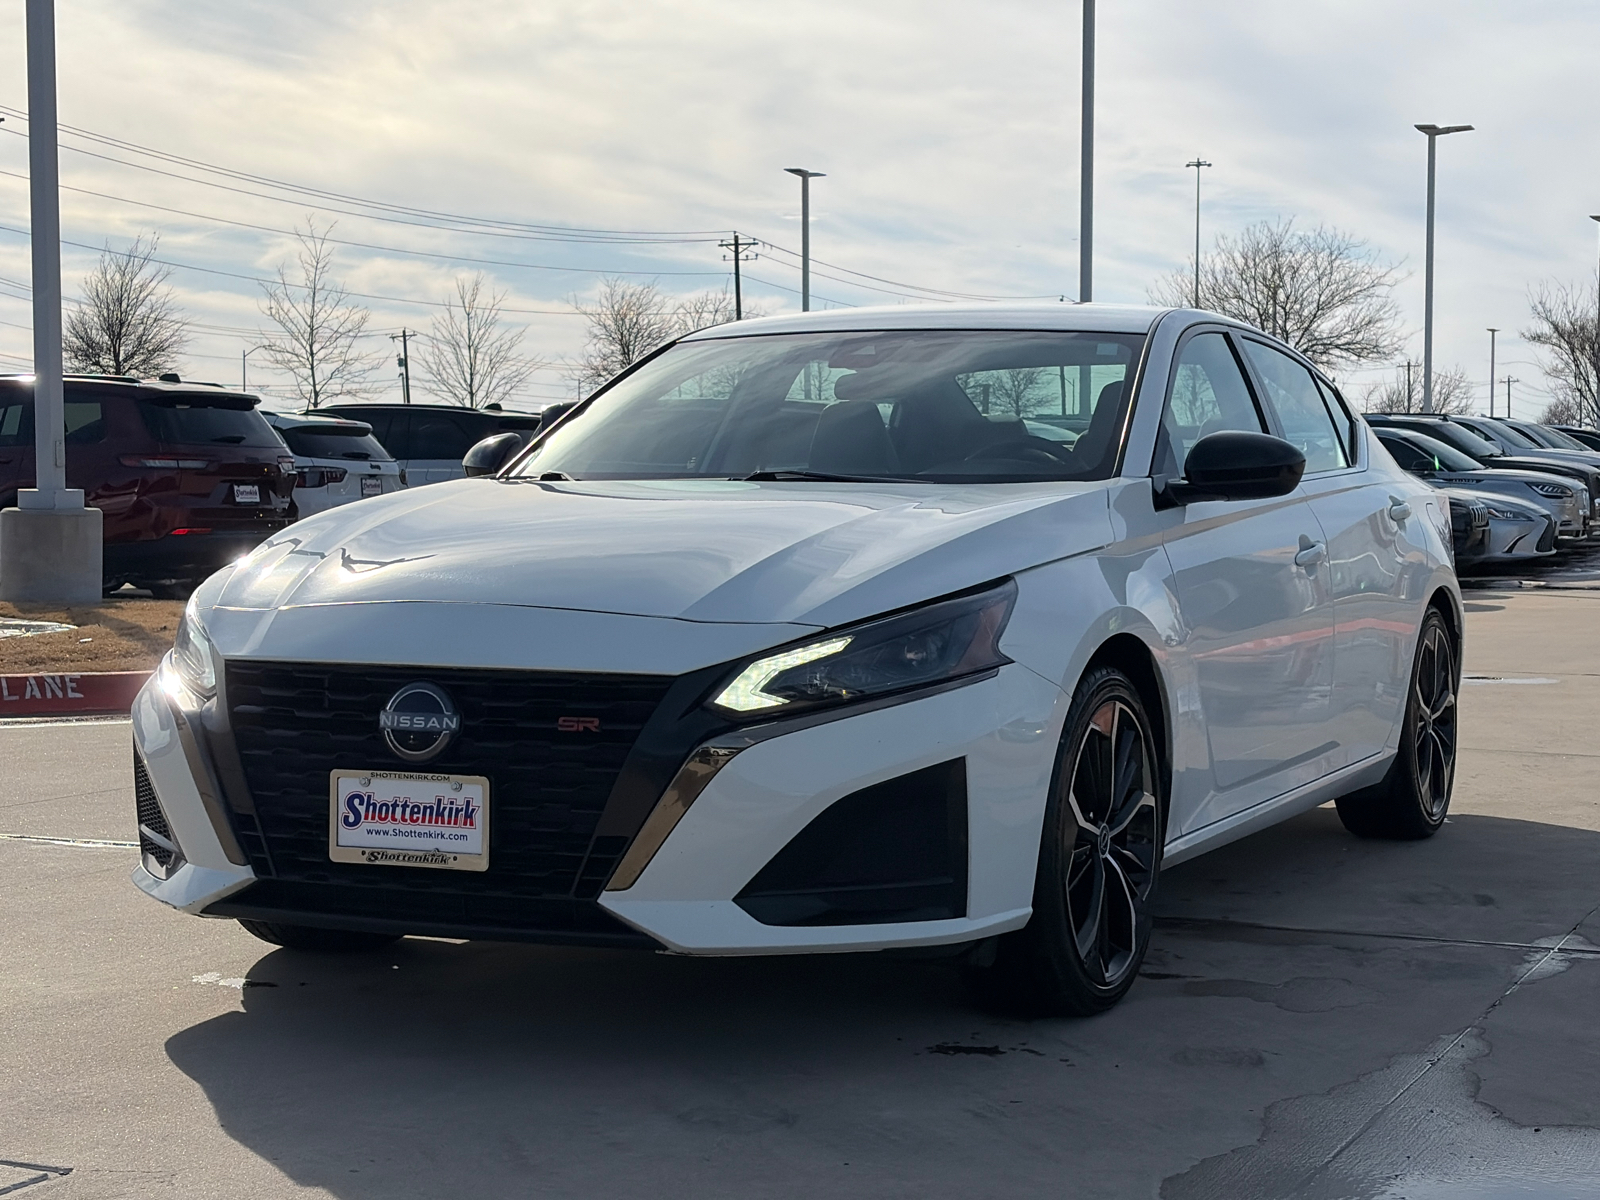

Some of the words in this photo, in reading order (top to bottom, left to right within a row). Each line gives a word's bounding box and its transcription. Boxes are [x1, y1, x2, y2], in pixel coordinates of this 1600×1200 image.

[0, 675, 84, 701] LANE
[381, 714, 457, 729] NISSAN
[557, 716, 600, 732] SR
[370, 771, 451, 782] SHOTTENKIRK.COM
[341, 791, 480, 830] Shottenkirk
[366, 827, 468, 842] www.Shottenkirk.com
[366, 850, 452, 866] Shottenkirk
